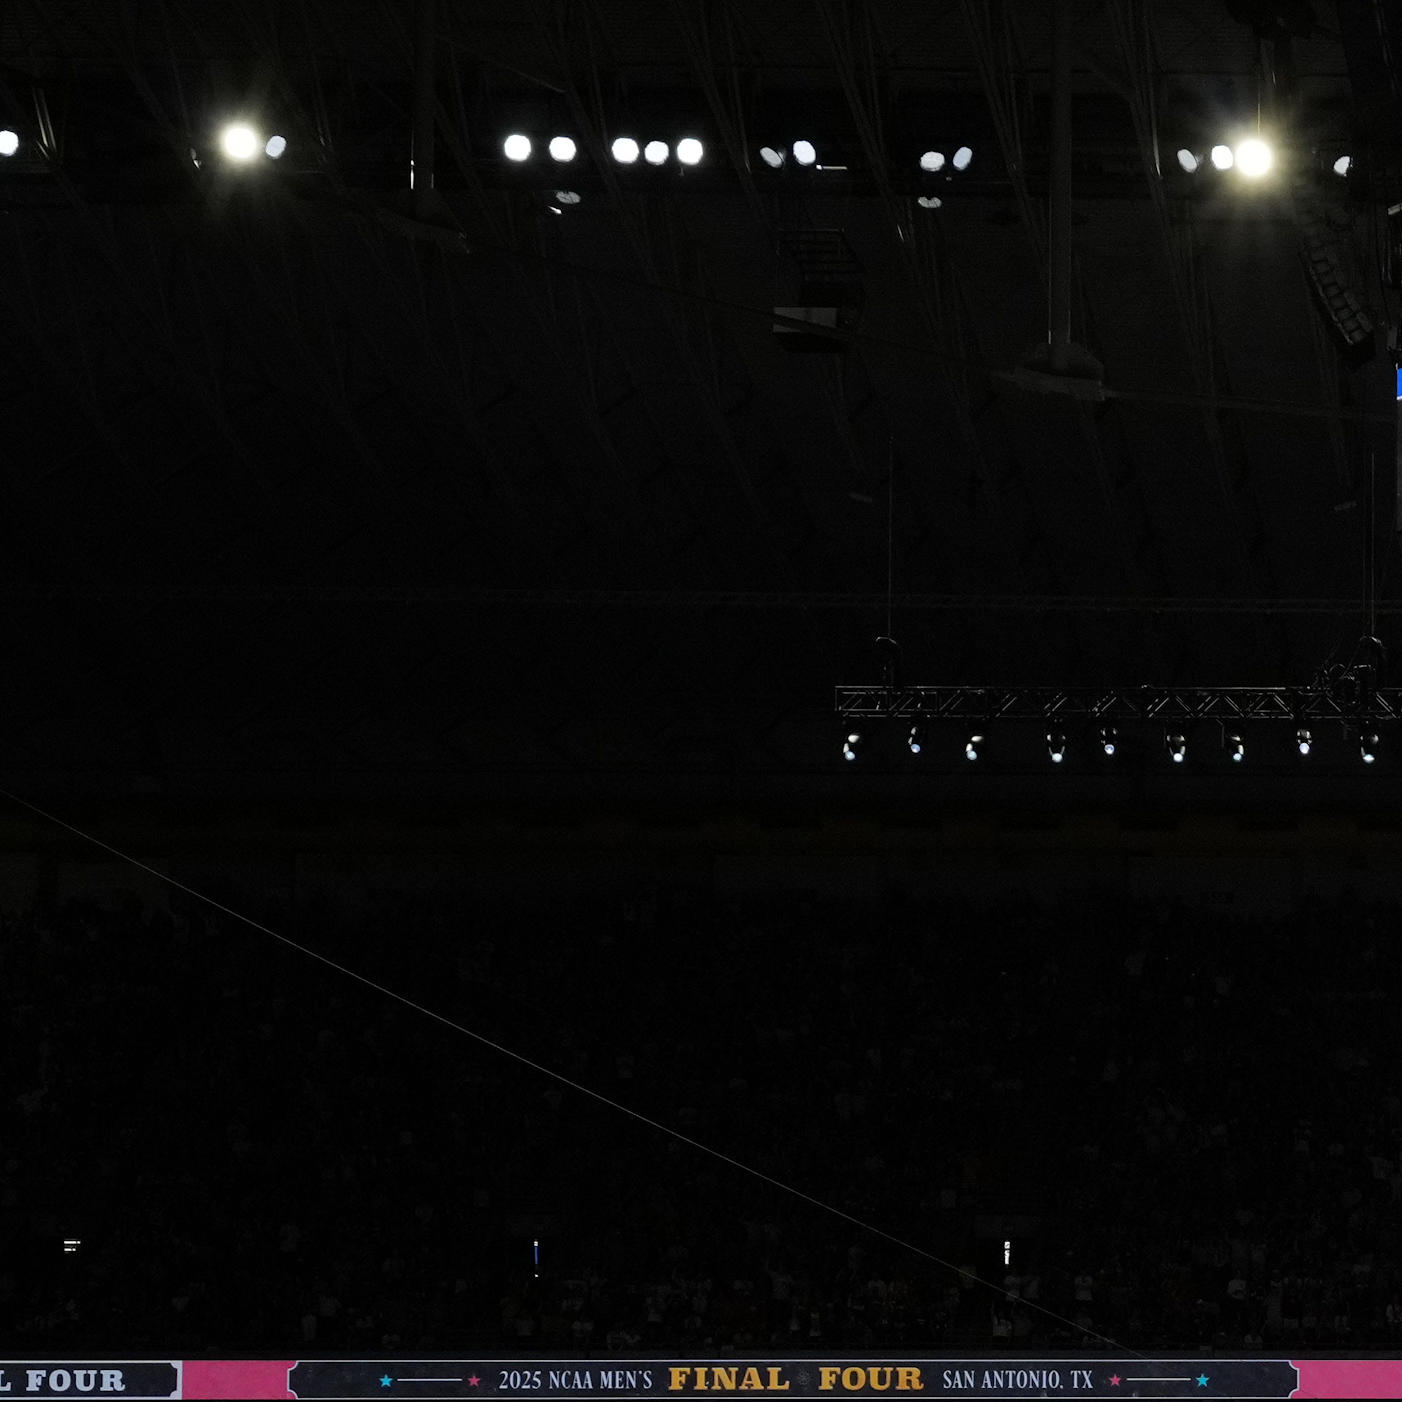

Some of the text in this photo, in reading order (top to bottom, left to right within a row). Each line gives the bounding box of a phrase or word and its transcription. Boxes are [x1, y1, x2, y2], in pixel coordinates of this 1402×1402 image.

[26, 1369, 126, 1392] FOUR
[499, 1367, 1093, 1391] 2025 NCAA MEN'S FINAL FOUR SAN TX
